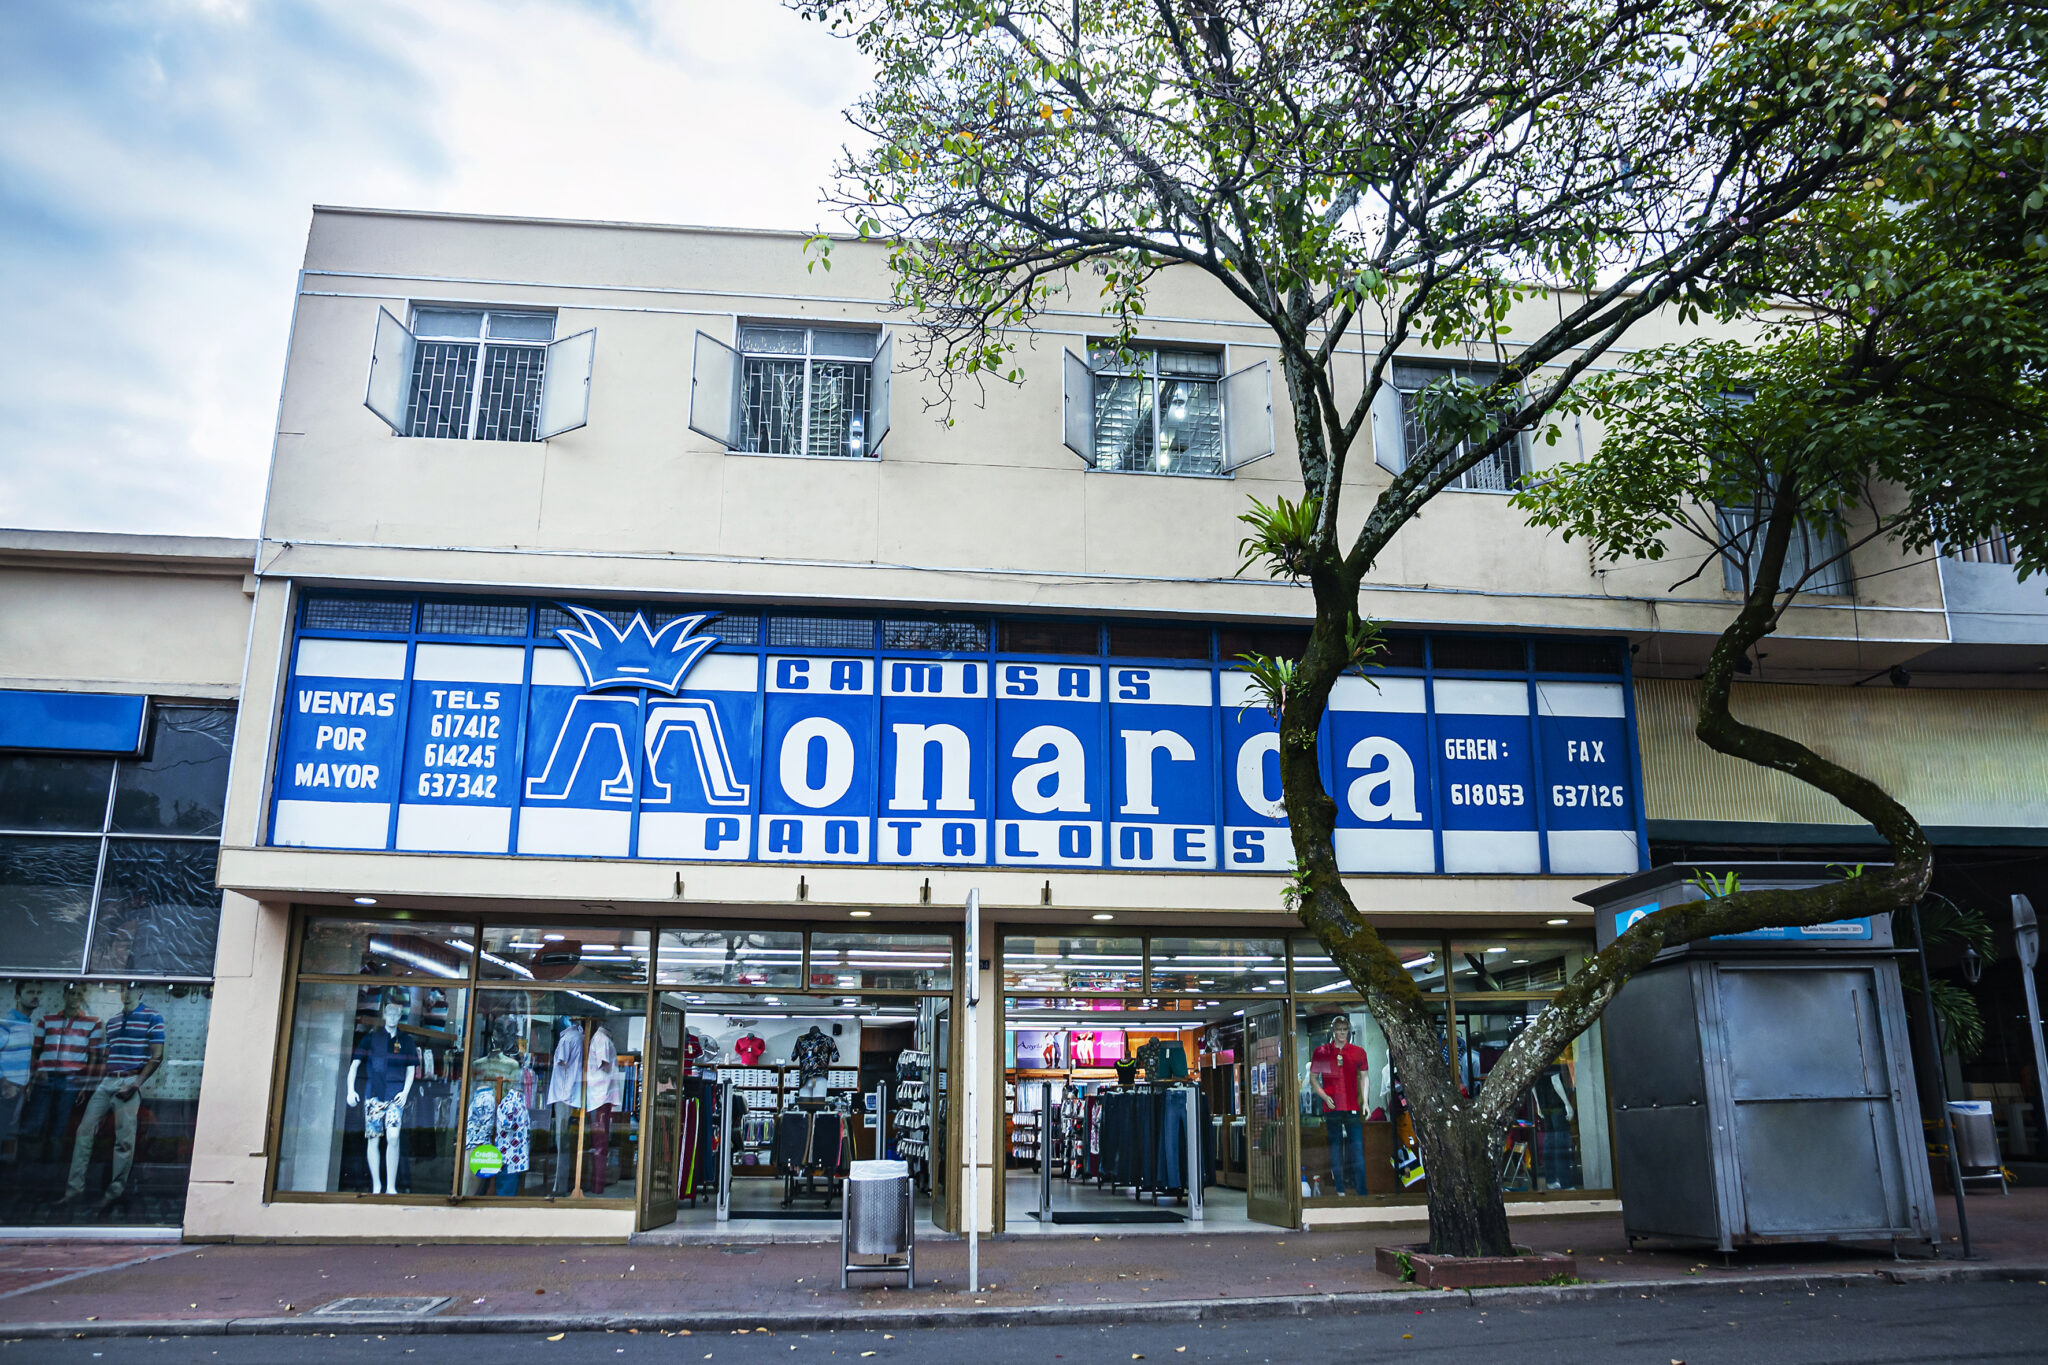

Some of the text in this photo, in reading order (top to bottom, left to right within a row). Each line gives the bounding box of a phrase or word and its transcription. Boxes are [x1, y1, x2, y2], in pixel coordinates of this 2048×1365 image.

[776, 659, 1151, 701] CAMISAS
[299, 690, 397, 717] VENTAS
[431, 689, 500, 710] TELS
[316, 725, 367, 752] POR
[430, 714, 500, 739] 617412
[424, 743, 496, 769] 614245
[1568, 740, 1606, 763] FAX
[295, 763, 379, 790] MAYOR
[418, 773, 497, 799] 637342
[1451, 783, 1525, 806] 618053
[1553, 785, 1624, 807] 637126
[705, 817, 1266, 865] PANTALONES
